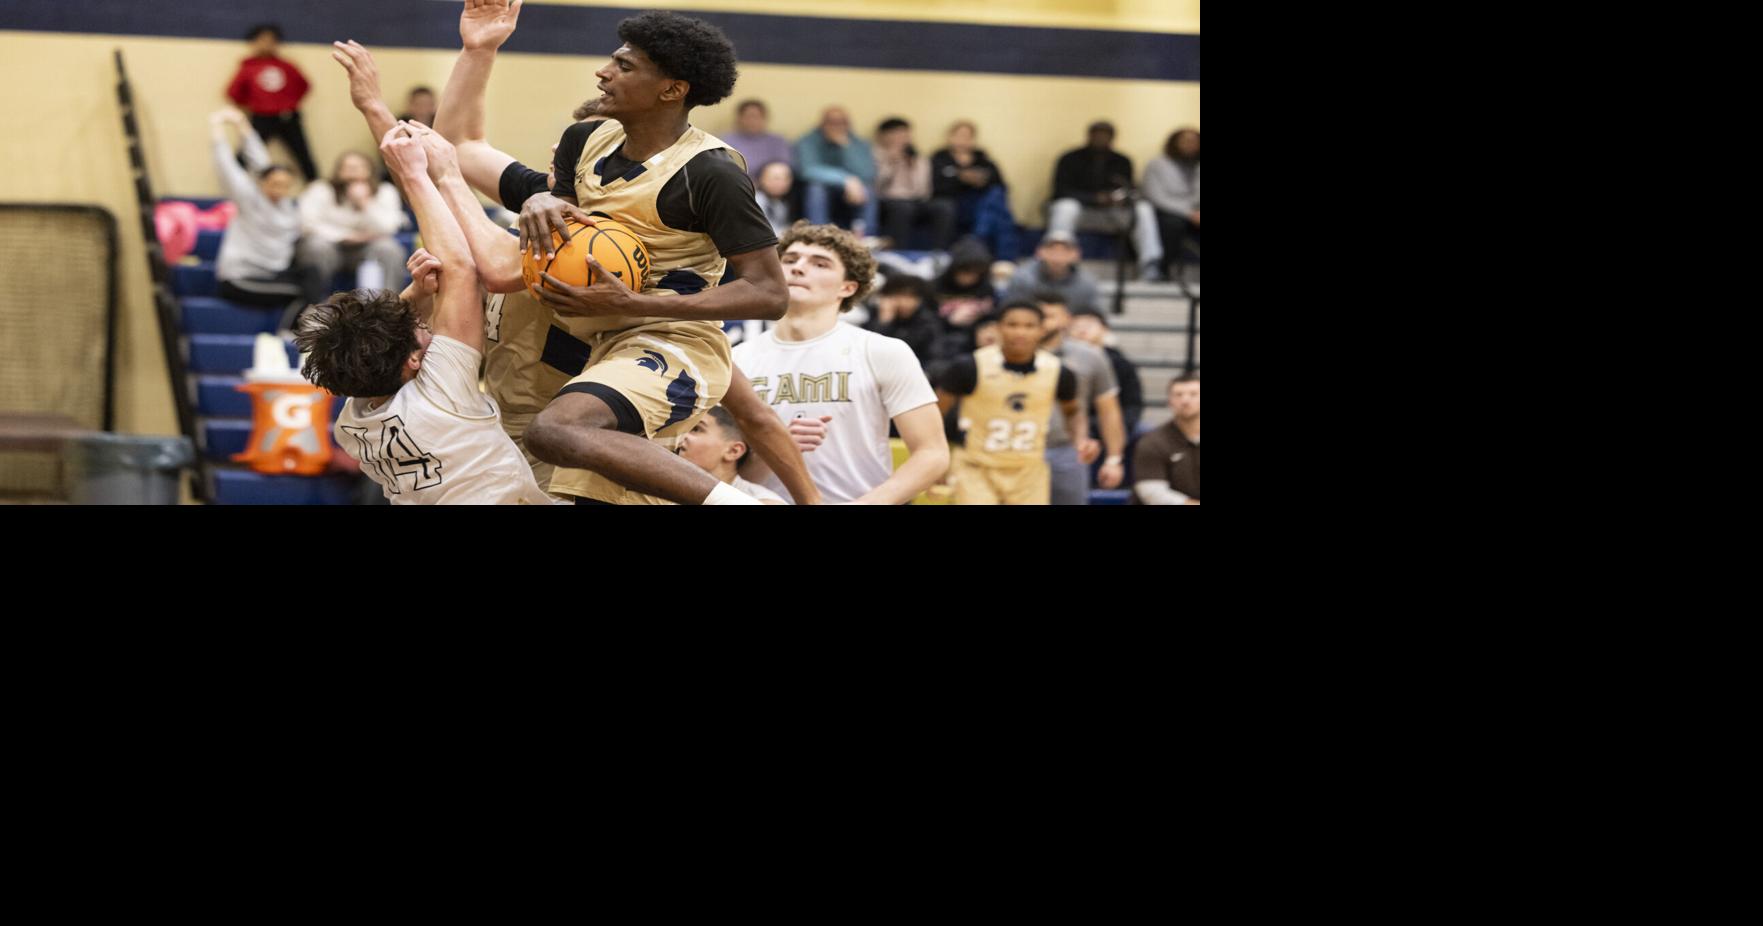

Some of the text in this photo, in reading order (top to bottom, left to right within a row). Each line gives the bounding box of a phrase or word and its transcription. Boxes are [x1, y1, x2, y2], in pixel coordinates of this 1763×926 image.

[272, 394, 313, 429] G
[984, 418, 1037, 451] 22
[341, 415, 442, 494] 14
